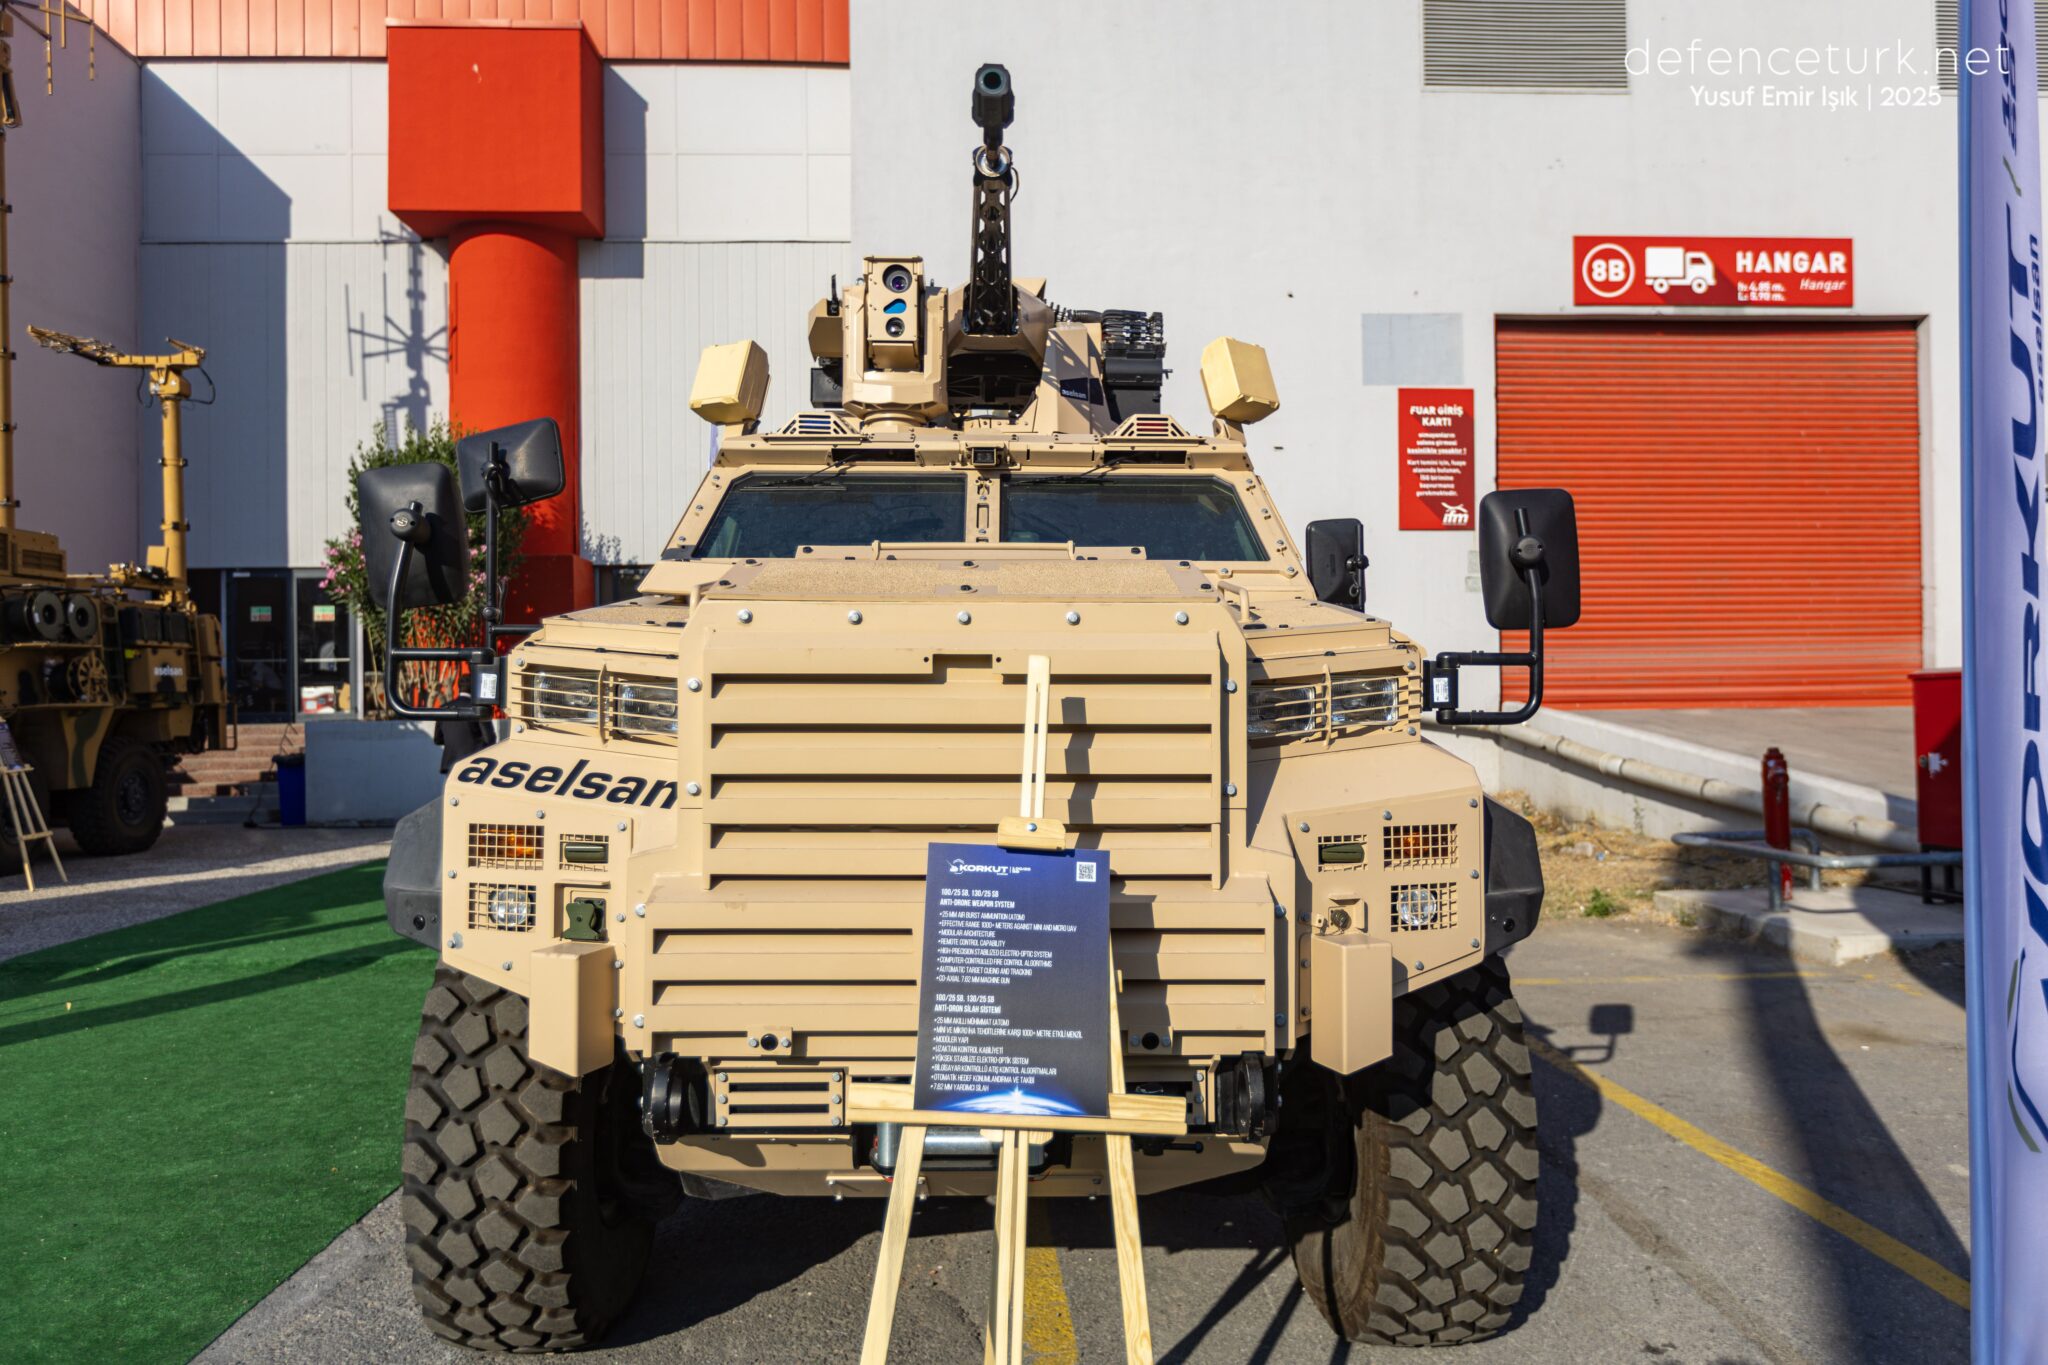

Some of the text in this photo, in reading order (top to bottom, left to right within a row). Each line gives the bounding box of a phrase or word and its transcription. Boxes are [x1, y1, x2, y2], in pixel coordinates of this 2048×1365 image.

[1735, 251, 1848, 274] HANGAR
[1591, 259, 1625, 282] 8B
[1799, 278, 1847, 293] Hangar
[2030, 233, 2044, 404] aselsan
[1410, 403, 1463, 417] FUAR GİRİŞ
[1422, 417, 1452, 427] KARTI
[1442, 510, 1469, 524] ifm
[457, 757, 678, 809] aselsan
[959, 864, 1008, 873] KORKUT
[994, 900, 1014, 908] SYSTEM
